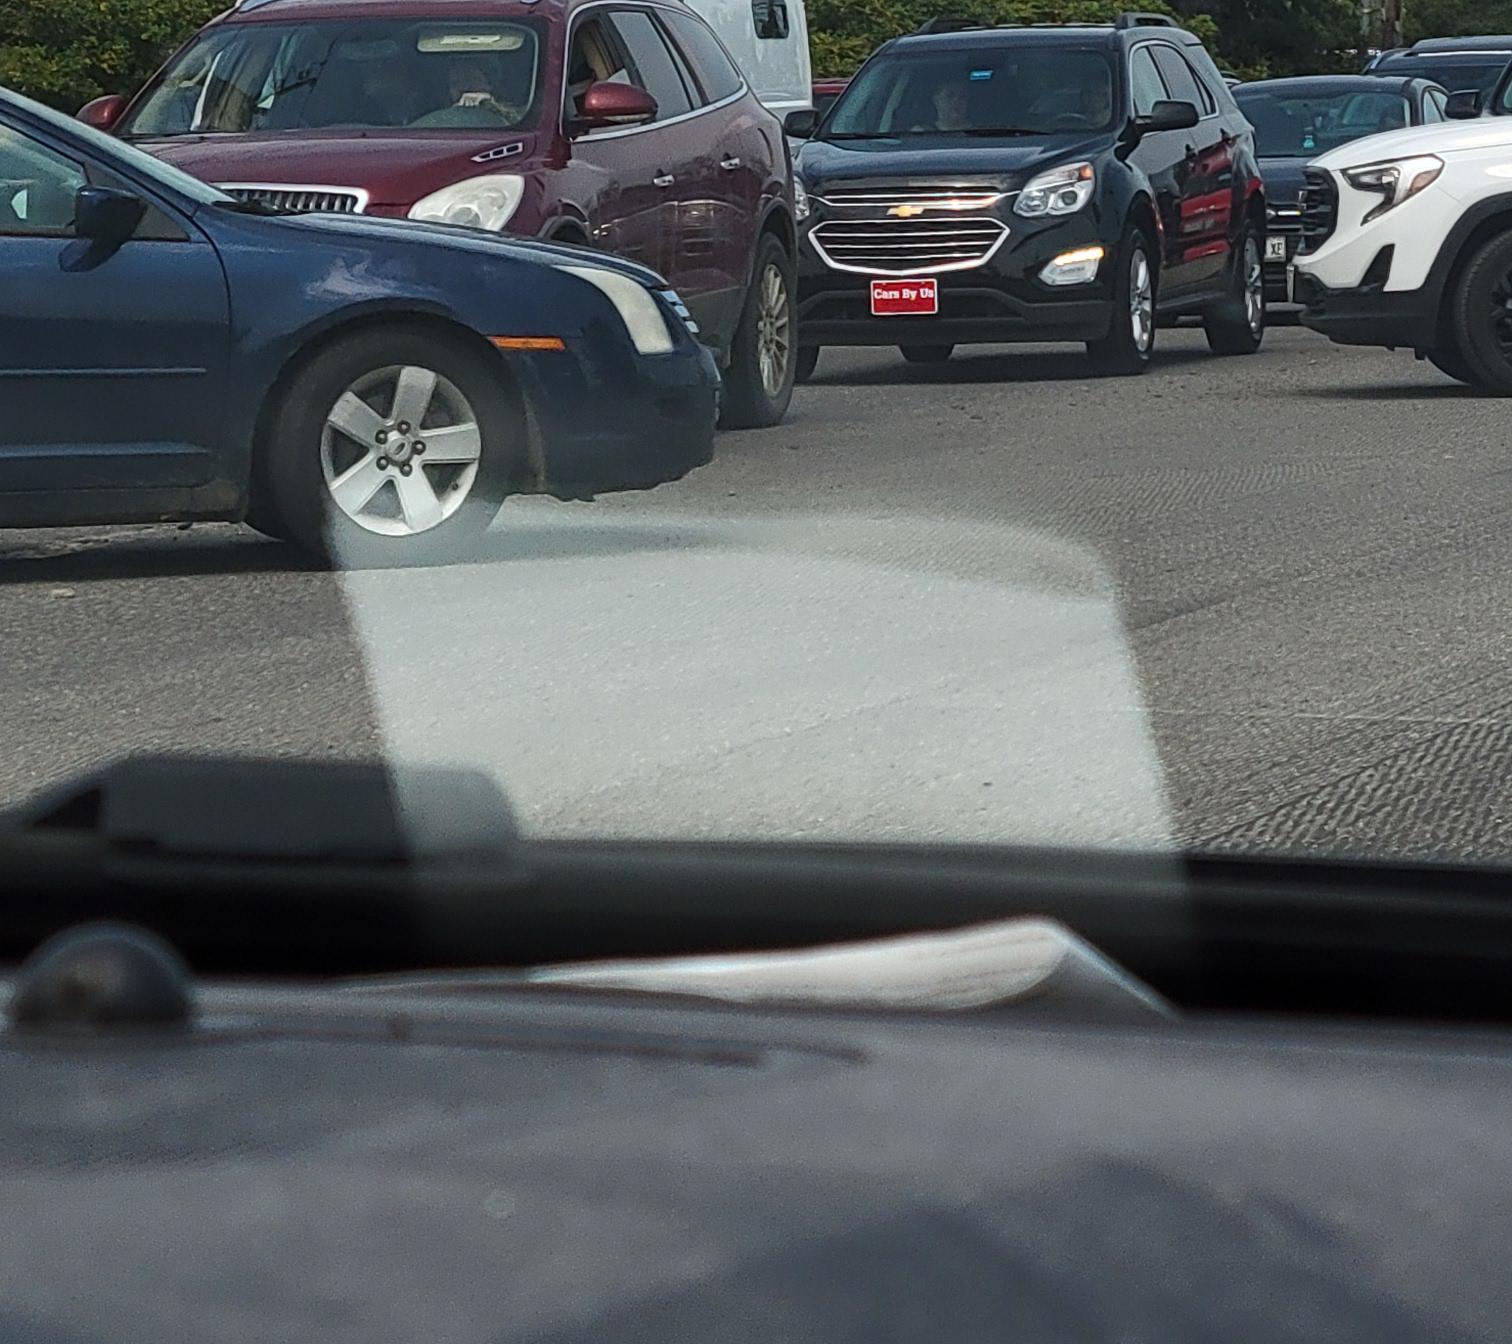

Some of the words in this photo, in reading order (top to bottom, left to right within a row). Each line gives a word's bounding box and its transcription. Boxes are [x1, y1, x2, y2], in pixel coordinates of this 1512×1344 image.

[874, 288, 900, 299] Cars
[902, 288, 917, 301] By
[920, 288, 934, 298] Us
